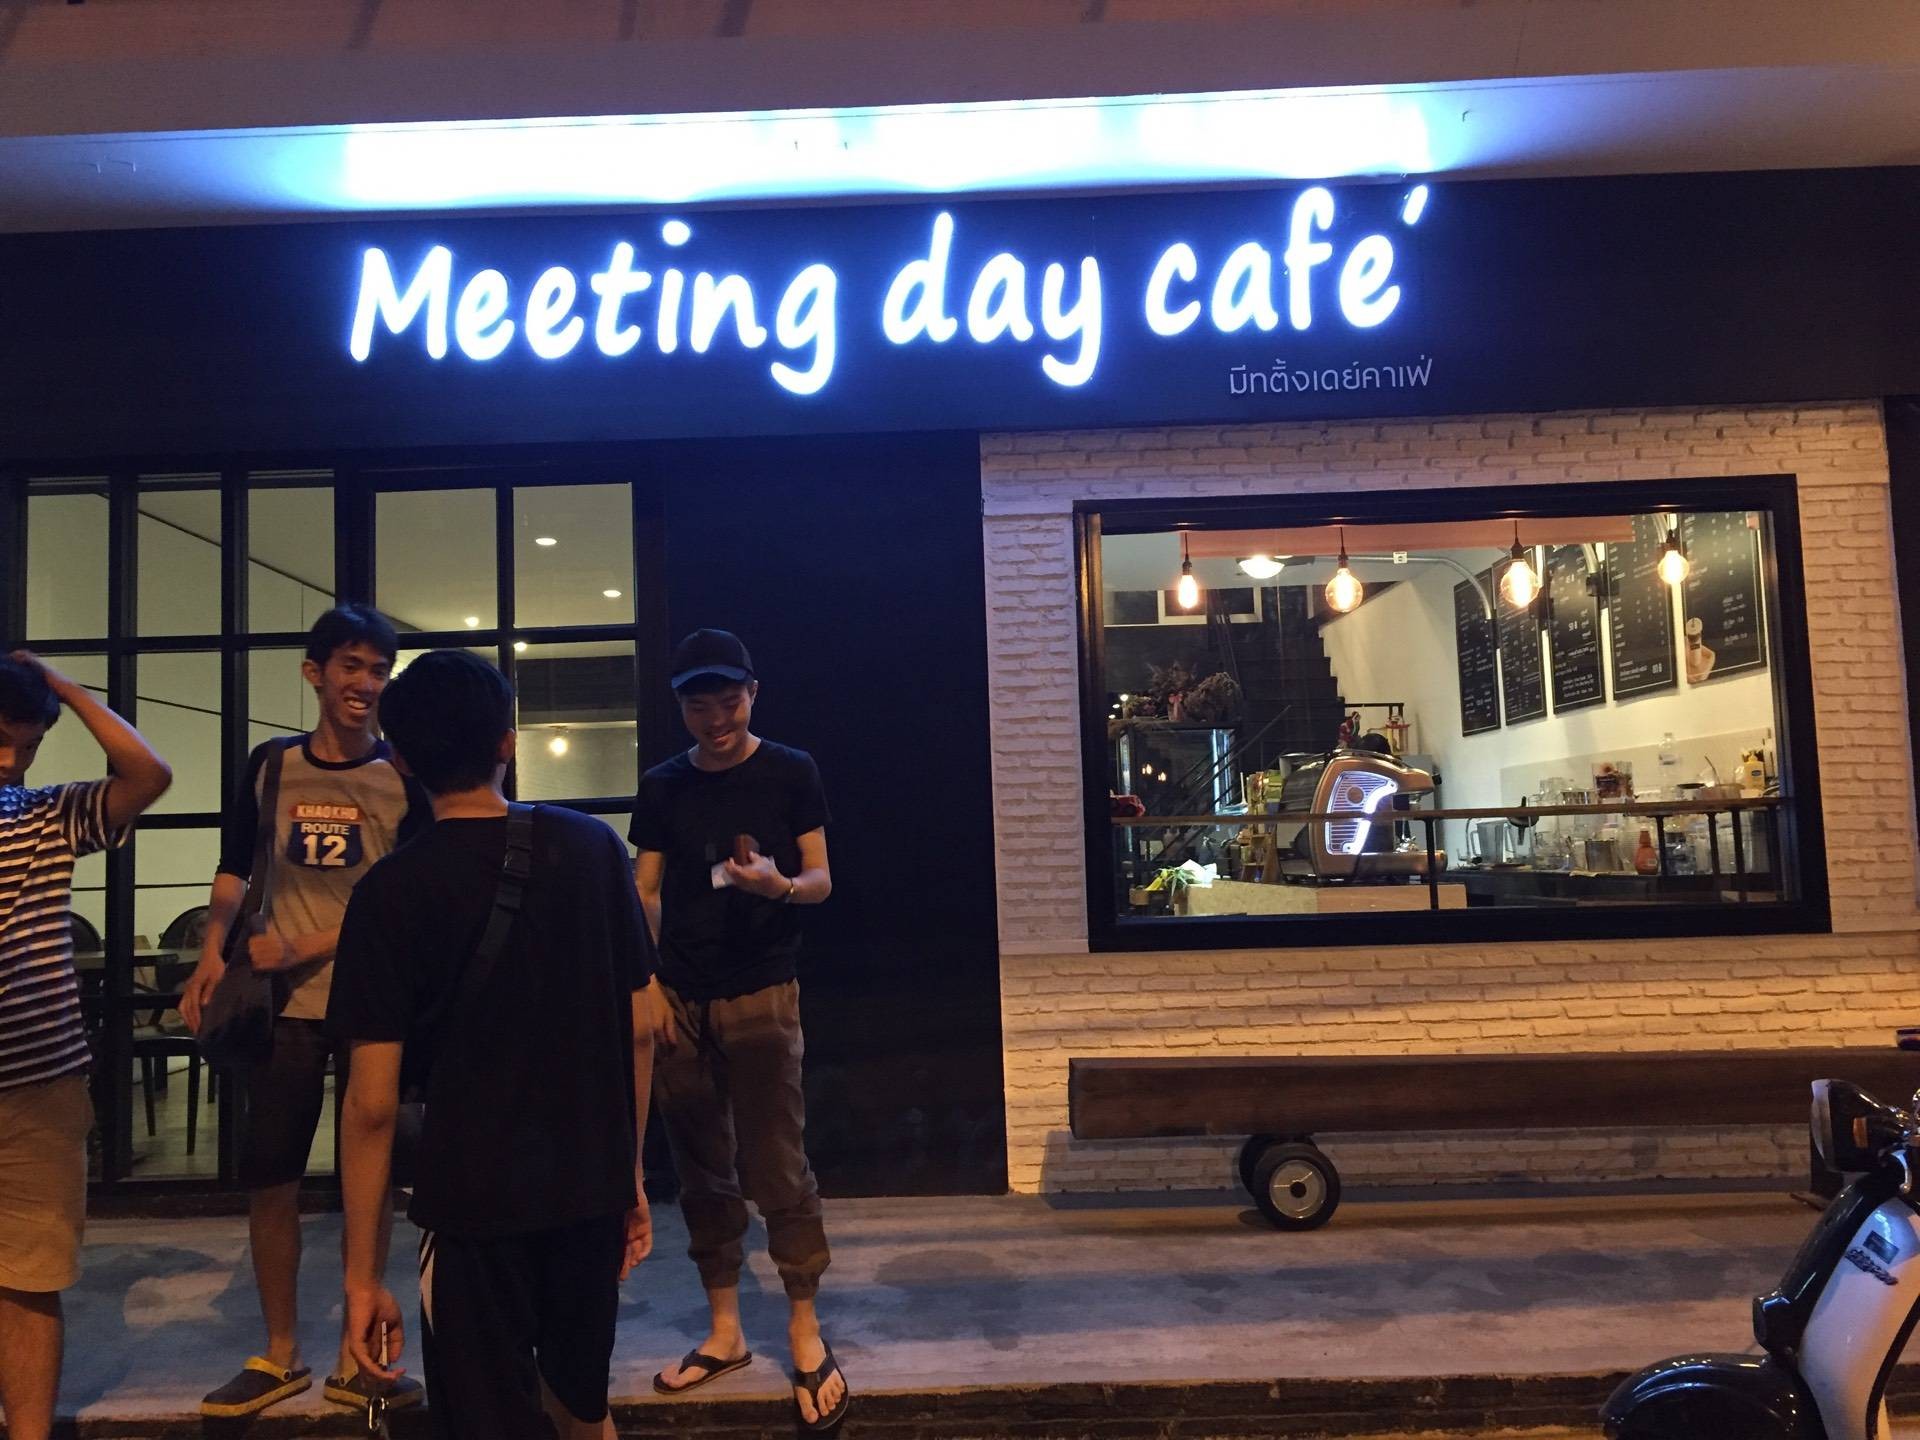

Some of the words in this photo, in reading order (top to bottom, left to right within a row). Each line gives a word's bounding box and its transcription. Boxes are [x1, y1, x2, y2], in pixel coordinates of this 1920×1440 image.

[350, 219, 837, 395] Meeting
[882, 211, 1102, 387] day
[300, 822, 350, 835] ROUTE
[303, 834, 347, 866] 12
